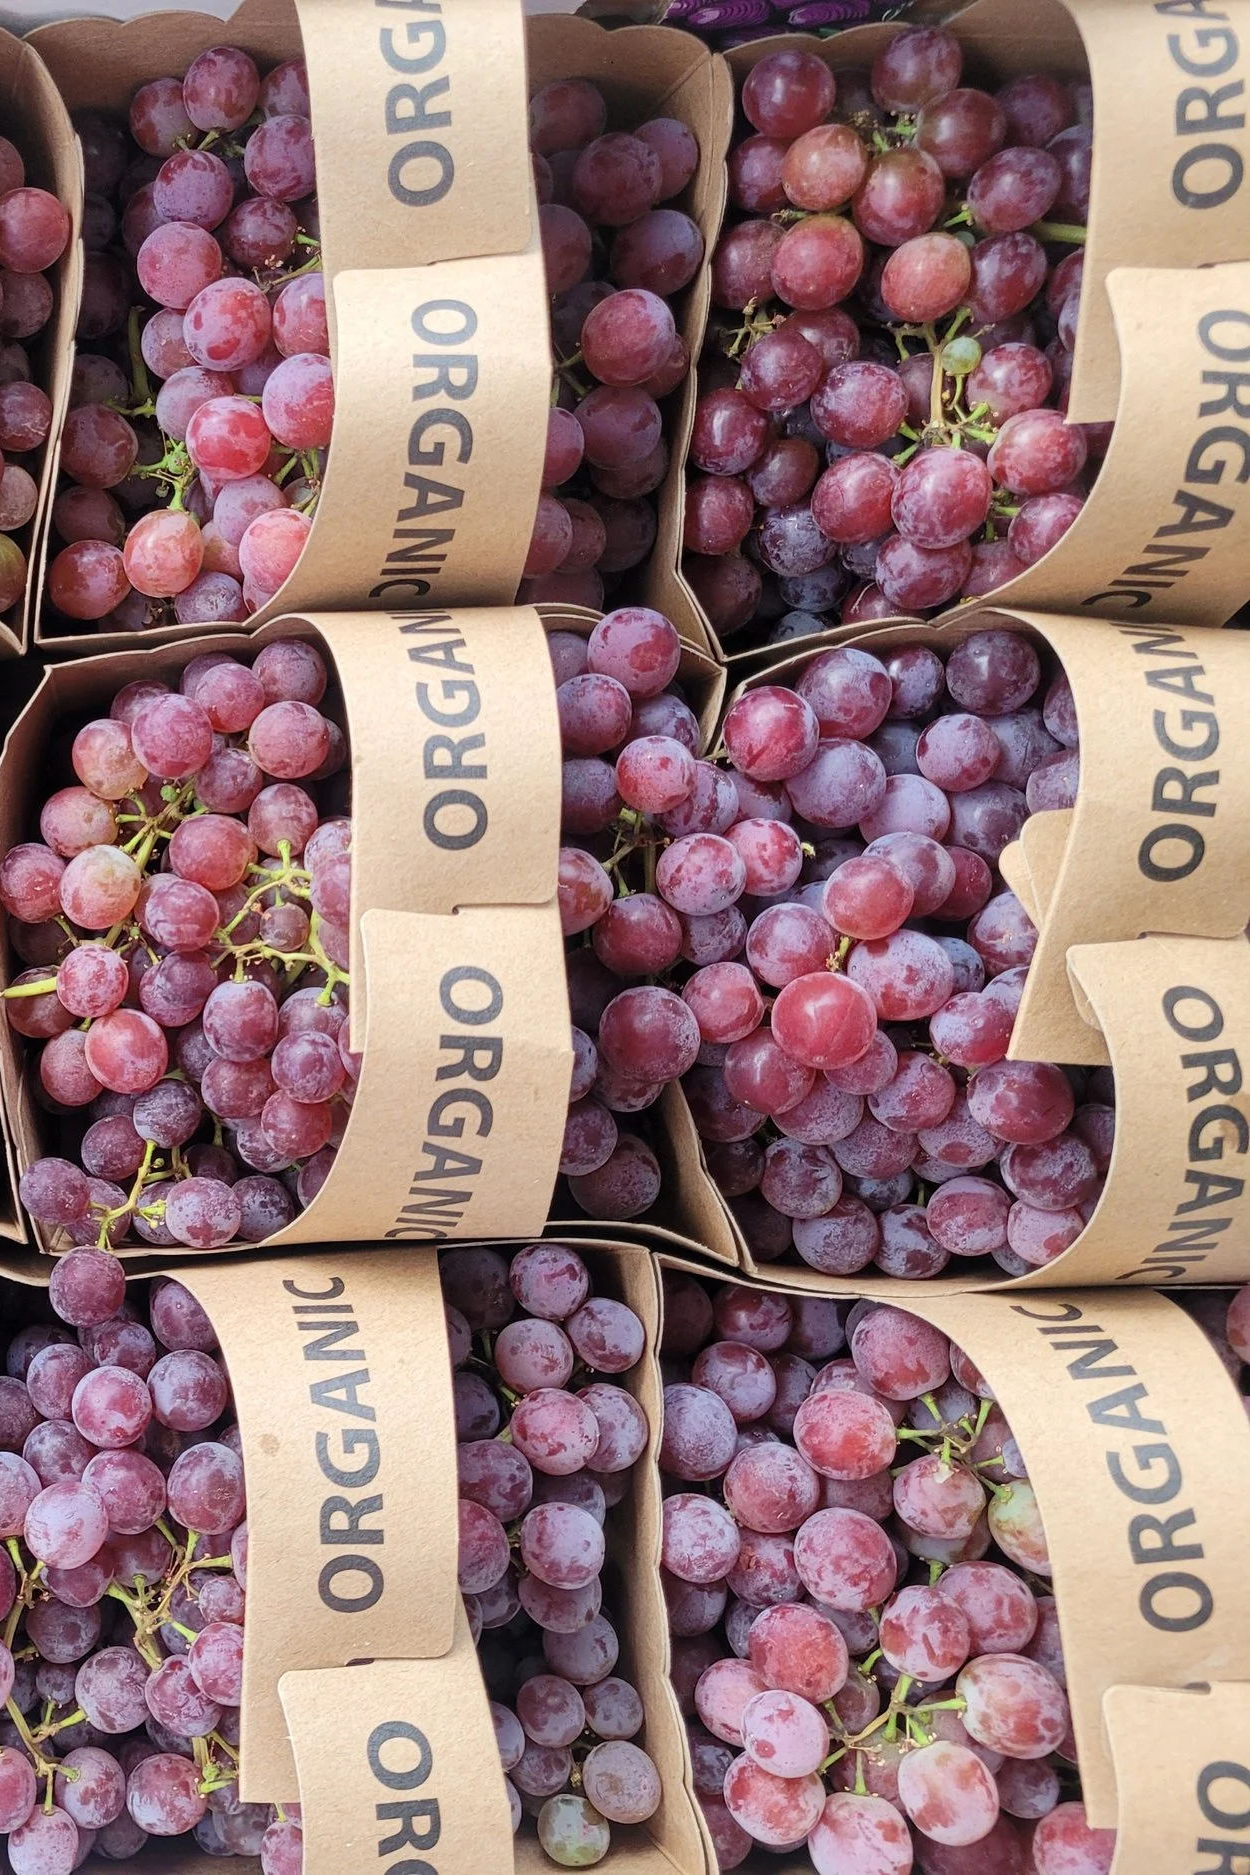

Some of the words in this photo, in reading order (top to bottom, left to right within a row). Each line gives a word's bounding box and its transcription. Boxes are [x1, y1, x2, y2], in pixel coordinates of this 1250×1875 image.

[368, 299, 479, 598] ORGANIC
[1081, 310, 1250, 608] ORGANIC
[384, 965, 503, 1238] ORGANIC
[1115, 985, 1249, 1280] ORGANIC
[282, 1276, 384, 1613] ORGANIC
[1010, 1303, 1214, 1633] ORGANIC
[366, 1720, 441, 1875] OR
